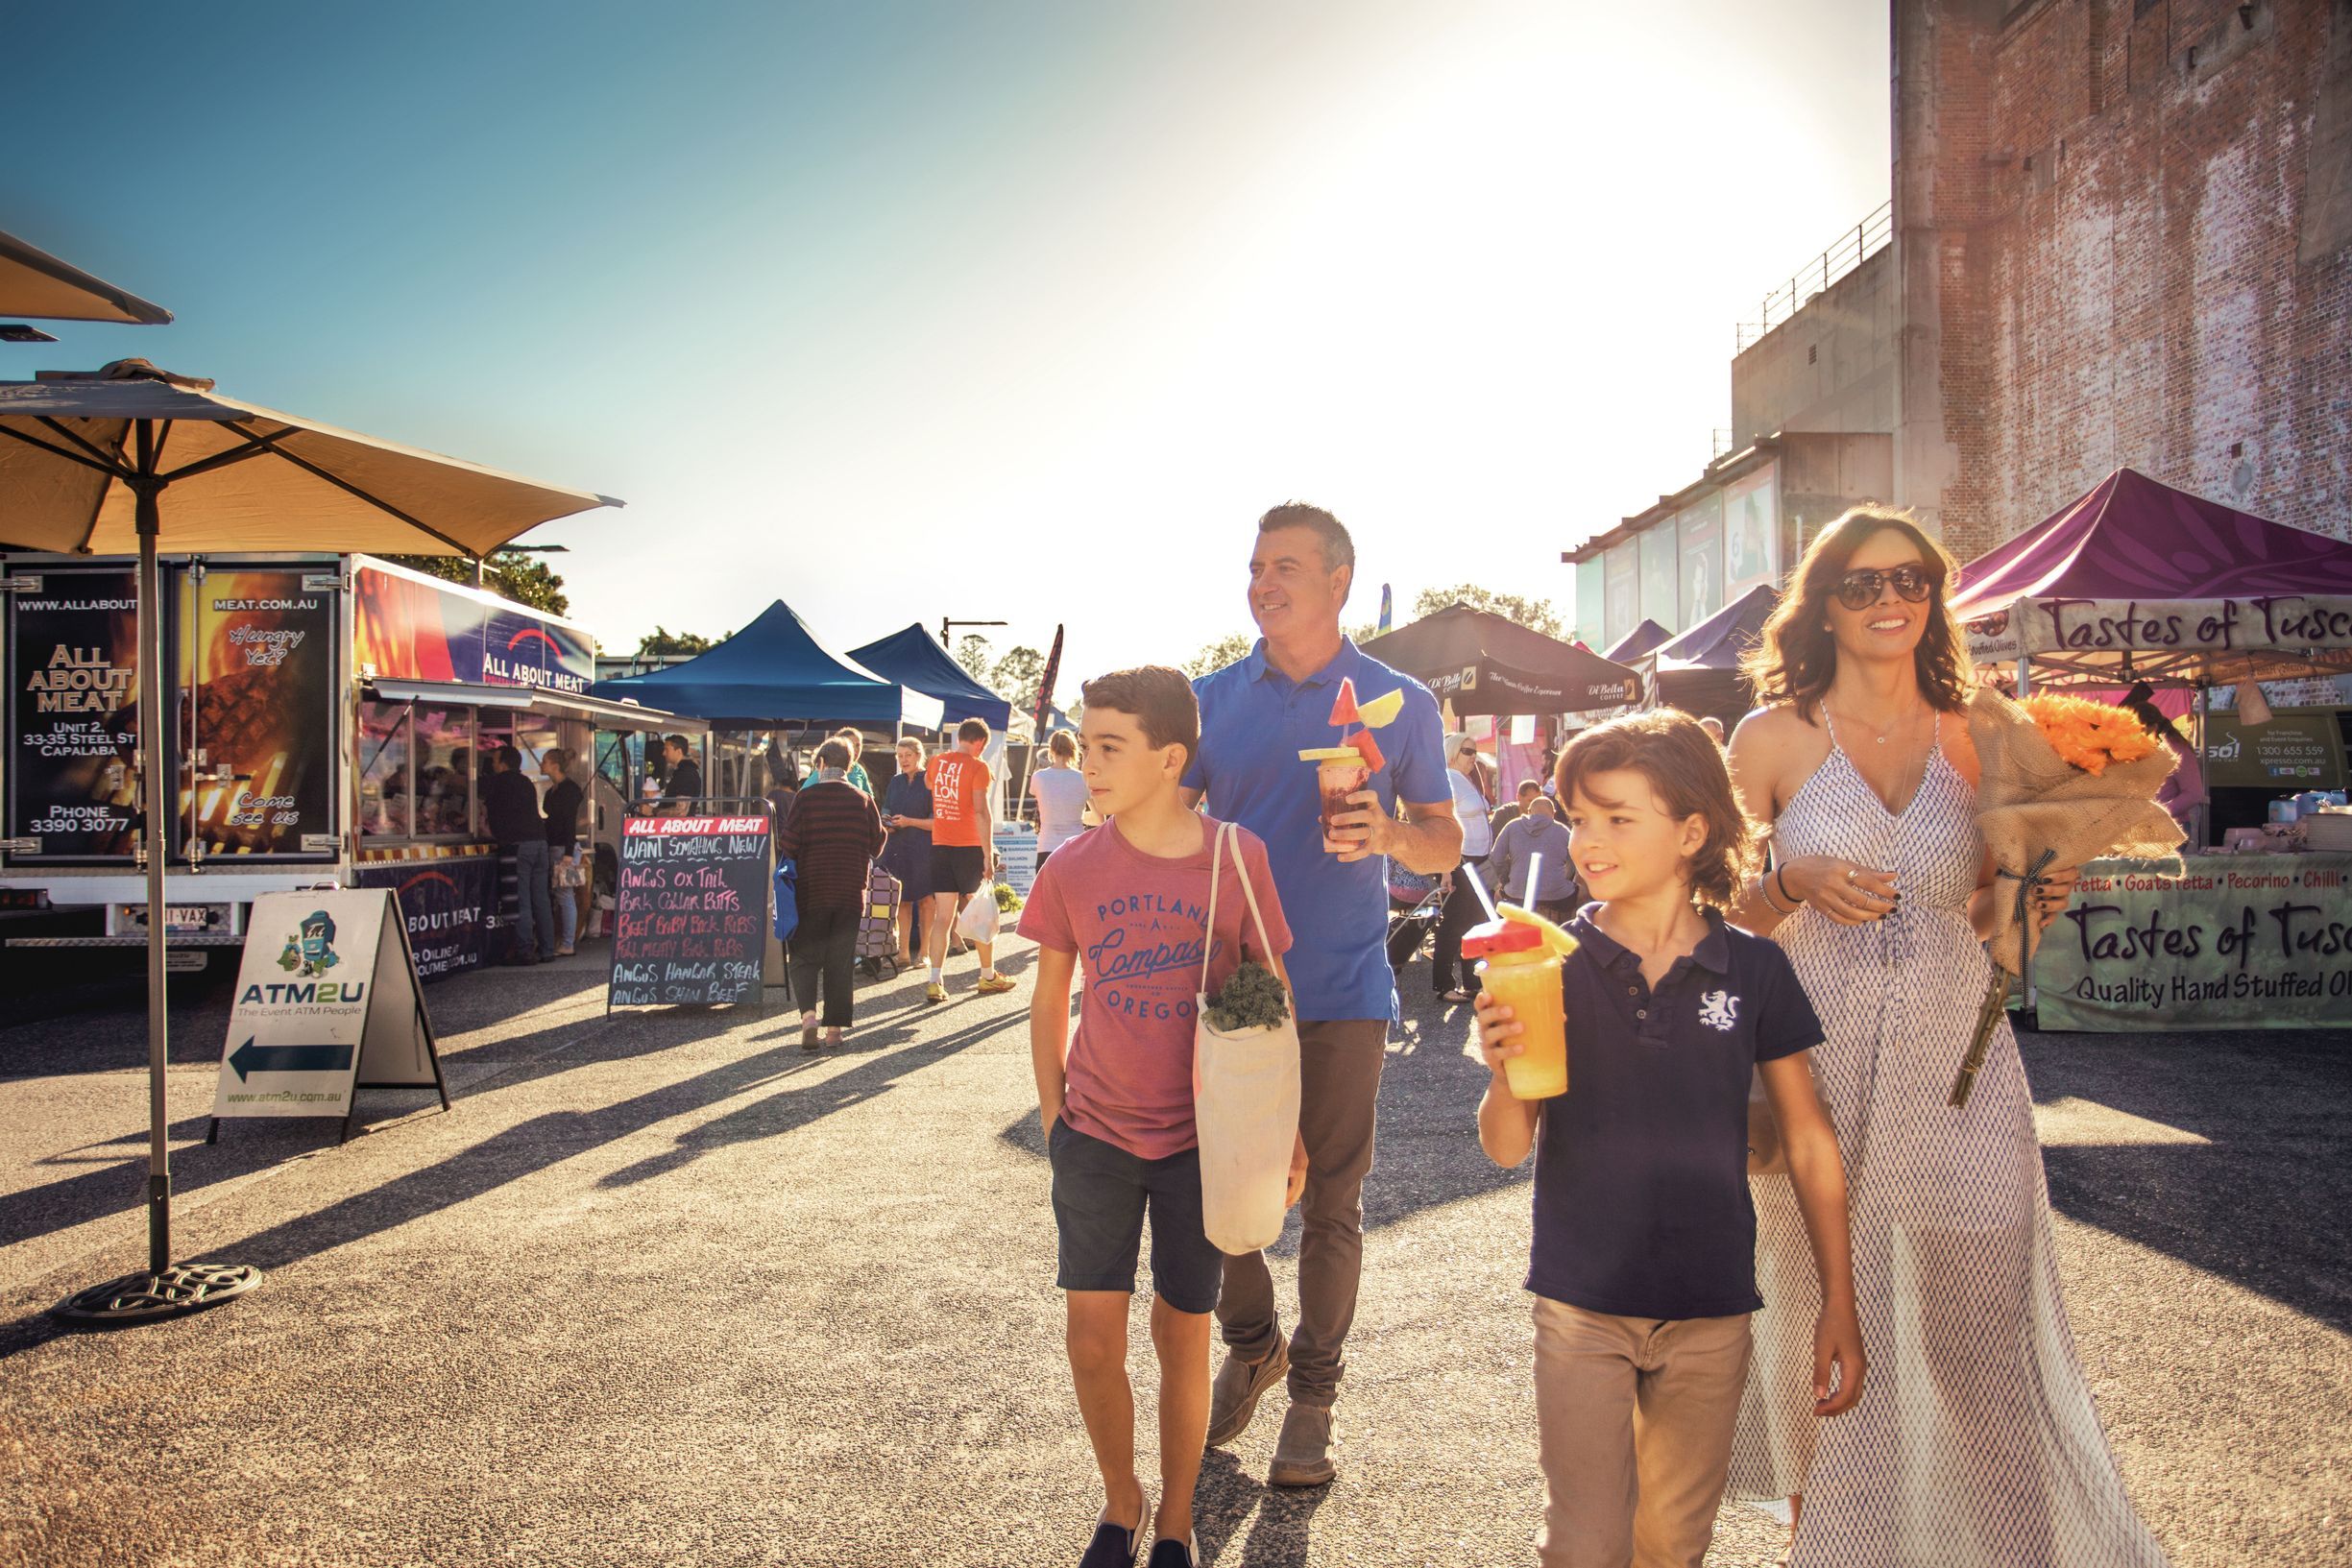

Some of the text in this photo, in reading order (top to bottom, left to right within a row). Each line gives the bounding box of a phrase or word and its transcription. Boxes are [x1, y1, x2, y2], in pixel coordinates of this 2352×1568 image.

[17, 599, 318, 611] WWW.ALLABOUT MEAT.COM.AU
[2039, 596, 2352, 650] Tastes of Tusc
[230, 624, 305, 652] Hungry
[245, 648, 285, 666] Yet?
[27, 669, 133, 691] ABOUT
[483, 653, 509, 677] ALL
[513, 663, 552, 687] ABOUT
[555, 672, 584, 692] MEAT
[1587, 683, 1624, 696] Di Bella
[37, 691, 123, 712] MEAT
[23, 734, 67, 745] 33-35
[2257, 746, 2324, 756] 1300 655 559
[938, 760, 963, 775] TRI
[2260, 758, 2326, 766] xpresso.com.au
[934, 772, 959, 787] ATH
[237, 792, 295, 808] Come
[934, 784, 958, 801] LON
[31, 818, 130, 832] 3390 3077
[230, 808, 300, 825] see us
[629, 818, 763, 833] ALL ABOUT MEAT
[623, 835, 766, 859] WANT SOMETHING NEW!
[2124, 875, 2171, 891] Goats
[2227, 873, 2291, 889] Pecorino
[2303, 870, 2340, 889] Chilli
[408, 912, 449, 933] BOUT
[2065, 902, 2203, 963] Tastes
[2216, 905, 2257, 970] of
[613, 963, 659, 984] ANGUS
[238, 982, 365, 1005] ATM2U
[613, 986, 658, 1004] ANGUS
[707, 980, 749, 1003] BEEF
[2076, 976, 2165, 1009] Quality
[2171, 974, 2228, 1001] Hand
[2234, 972, 2322, 998] Stuffed
[238, 1006, 362, 1018] The Event ATM People
[1107, 990, 1199, 1021] OREGO
[227, 1091, 343, 1103] www.atm2u.com.au
